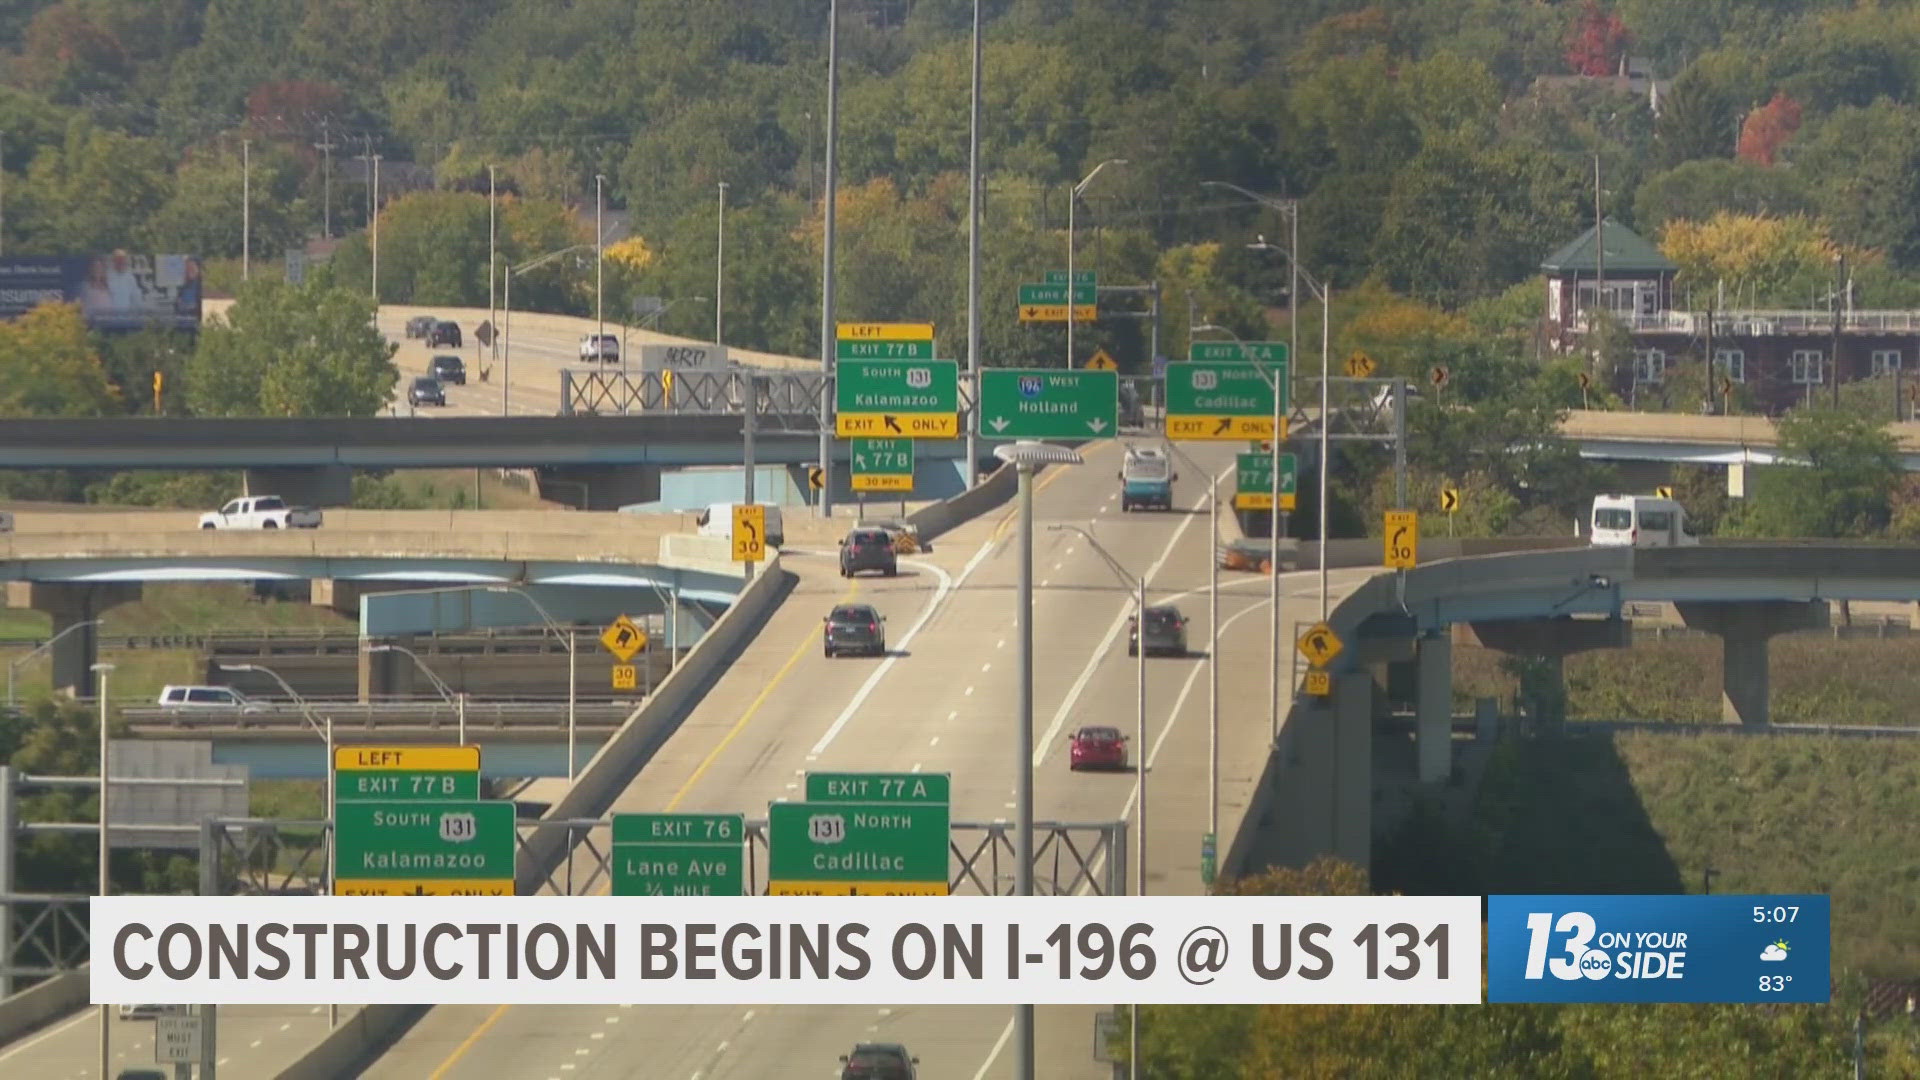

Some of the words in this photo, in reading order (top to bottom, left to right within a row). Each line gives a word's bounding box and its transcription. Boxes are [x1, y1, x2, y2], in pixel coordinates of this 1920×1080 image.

[1031, 290, 1060, 300] Lane
[851, 326, 882, 337] LEFT
[851, 344, 880, 355] EXIT
[1205, 347, 1232, 357] EXIT
[909, 370, 929, 385] 131
[1195, 372, 1215, 386] 131
[1020, 380, 1041, 394] 196
[854, 393, 938, 407] Kalamazoo
[1194, 396, 1257, 408] Cadillac
[1018, 401, 1078, 414] Holland
[844, 419, 874, 431] EXIT
[912, 419, 948, 431] ONLY
[1174, 421, 1203, 433] EXIT
[867, 439, 896, 450] EXIT
[739, 540, 759, 553] 30
[1390, 546, 1411, 560] 30
[615, 667, 633, 680] 30
[358, 752, 402, 766] LEFT
[358, 778, 400, 793] EXIT
[828, 780, 870, 796] EXIT
[373, 812, 431, 827] SOUTH
[443, 817, 474, 837] 131
[652, 822, 694, 837] EXIT
[704, 821, 731, 838] 76
[812, 819, 843, 838] 131
[854, 813, 912, 829] NORTH
[363, 852, 486, 869] Kalamazoo
[814, 853, 905, 871] Cadillac
[627, 860, 682, 877] Lane
[688, 860, 727, 877] Ave
[674, 883, 711, 896] MILE
[167, 1033, 191, 1043] MUST
[169, 1047, 189, 1058] EXIT
